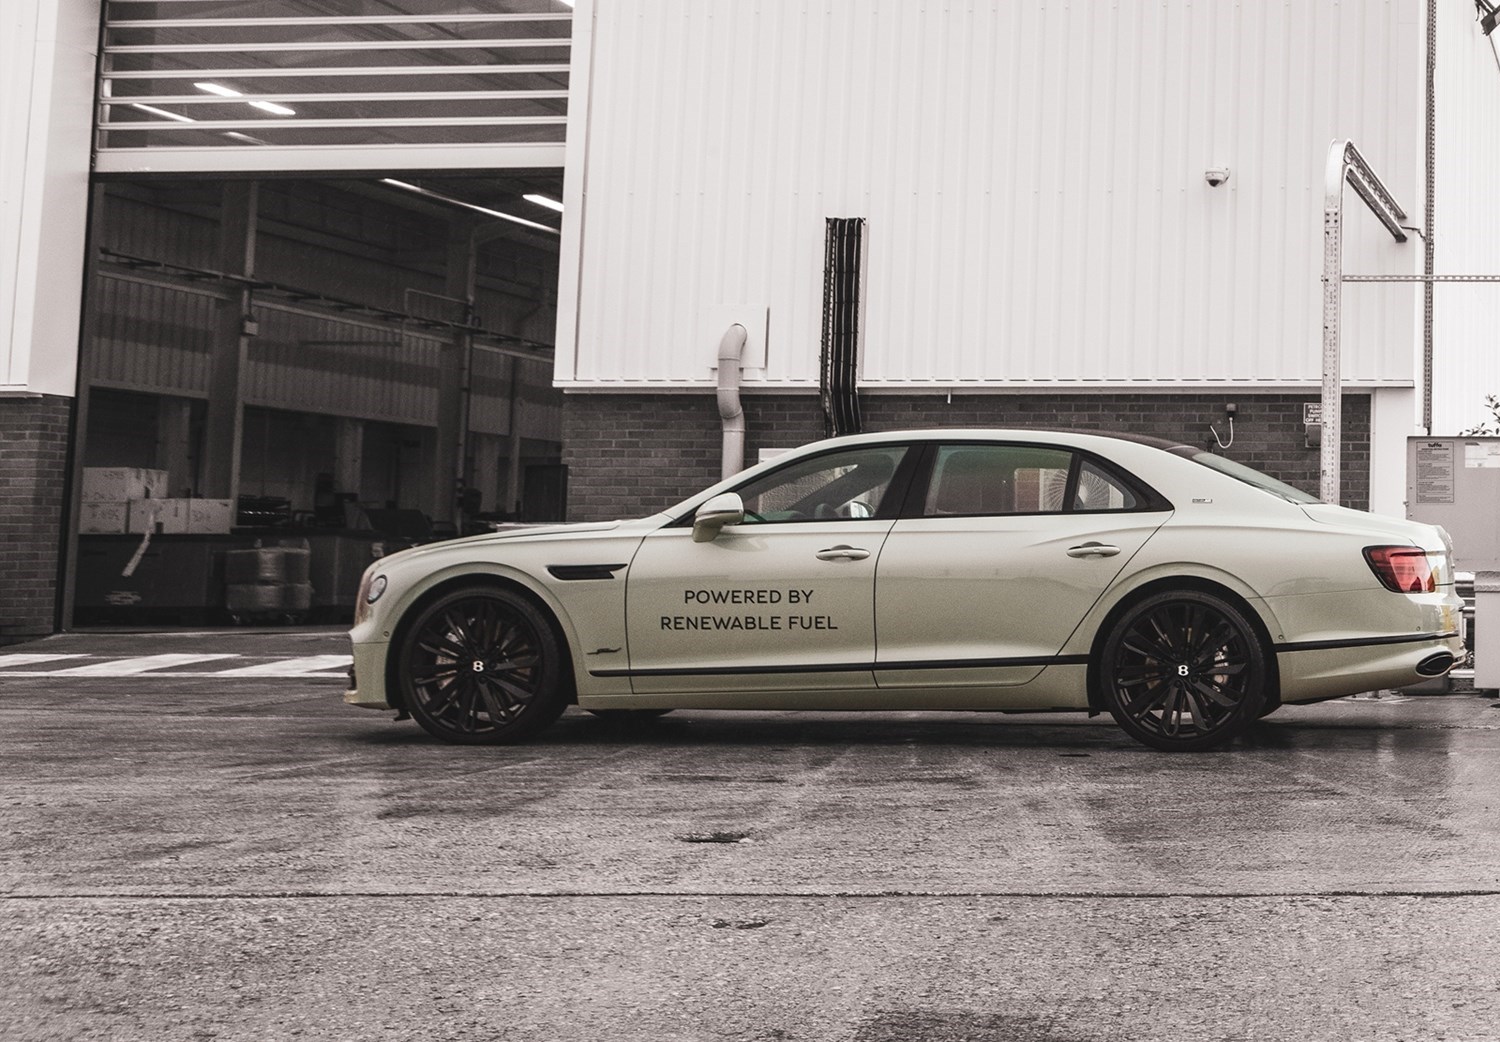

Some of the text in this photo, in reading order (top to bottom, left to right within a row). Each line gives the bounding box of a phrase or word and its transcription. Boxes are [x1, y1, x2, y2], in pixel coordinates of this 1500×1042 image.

[684, 590, 814, 604] POWERED BY
[661, 616, 838, 630] RENEWABLE FUEL
[473, 661, 484, 672] B
[1178, 665, 1189, 676] B
